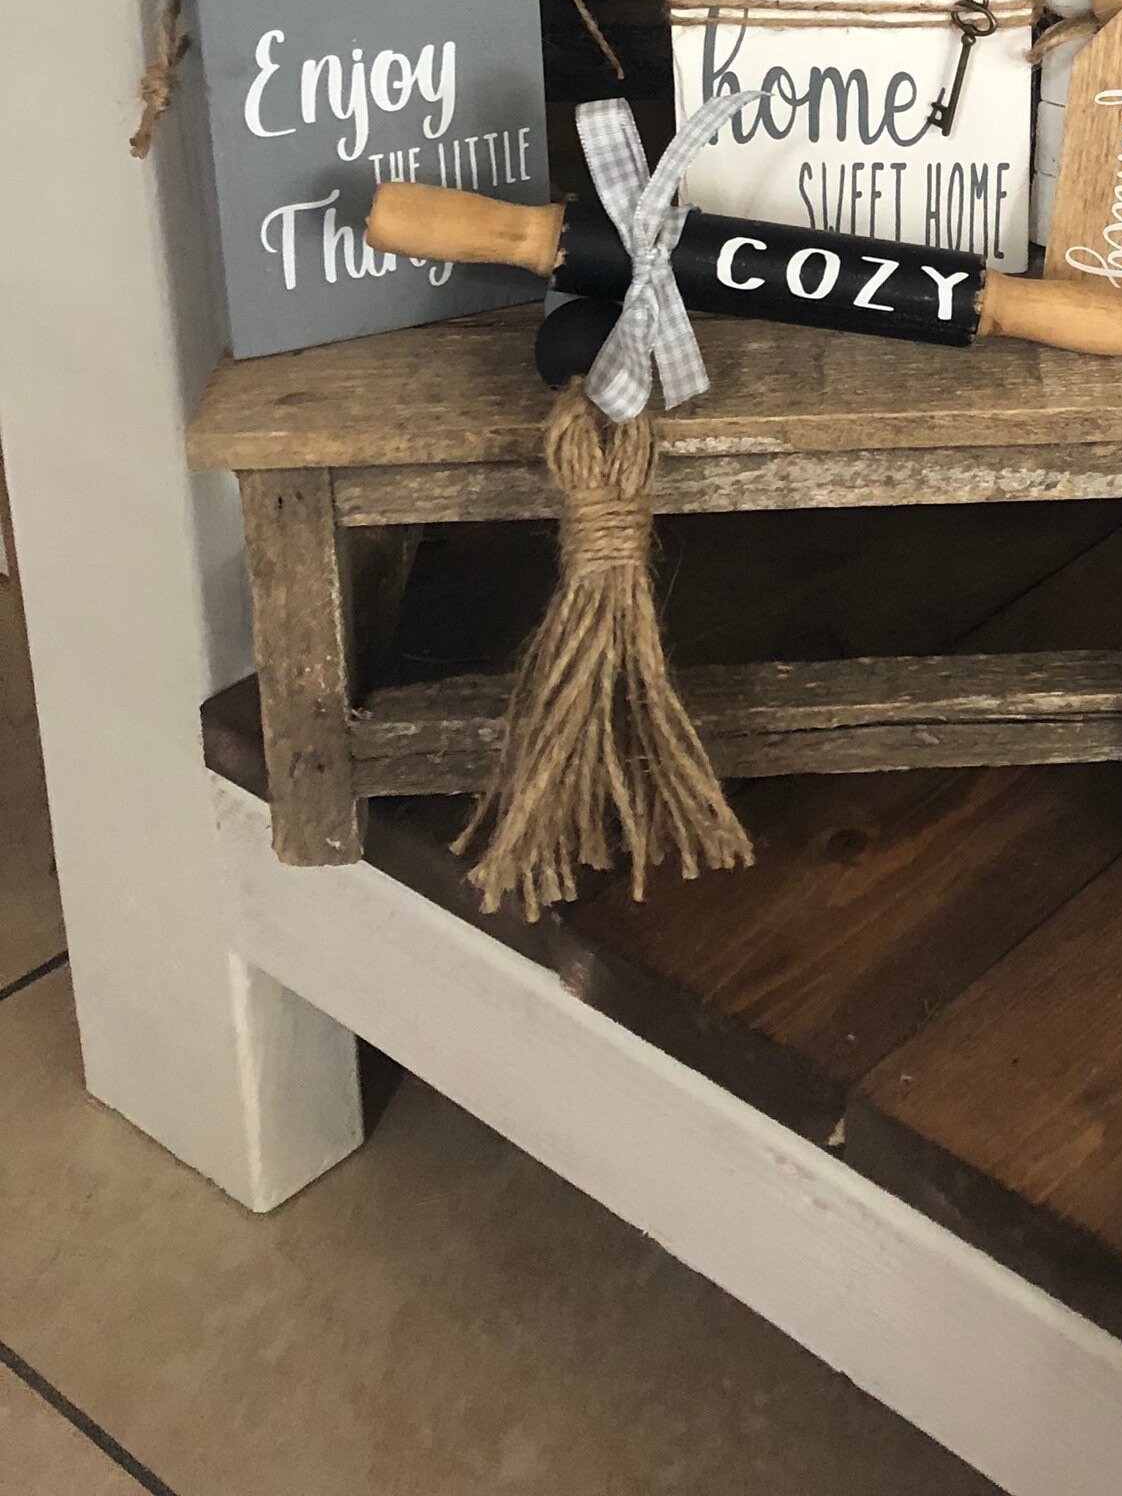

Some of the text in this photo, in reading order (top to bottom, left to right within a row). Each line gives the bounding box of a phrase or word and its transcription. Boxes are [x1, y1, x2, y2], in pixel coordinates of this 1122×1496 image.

[244, 29, 456, 162] Enjoy
[368, 127, 532, 190] THE LITTLE
[798, 162, 1010, 259] SWEET HOME
[716, 236, 969, 321] COZY
